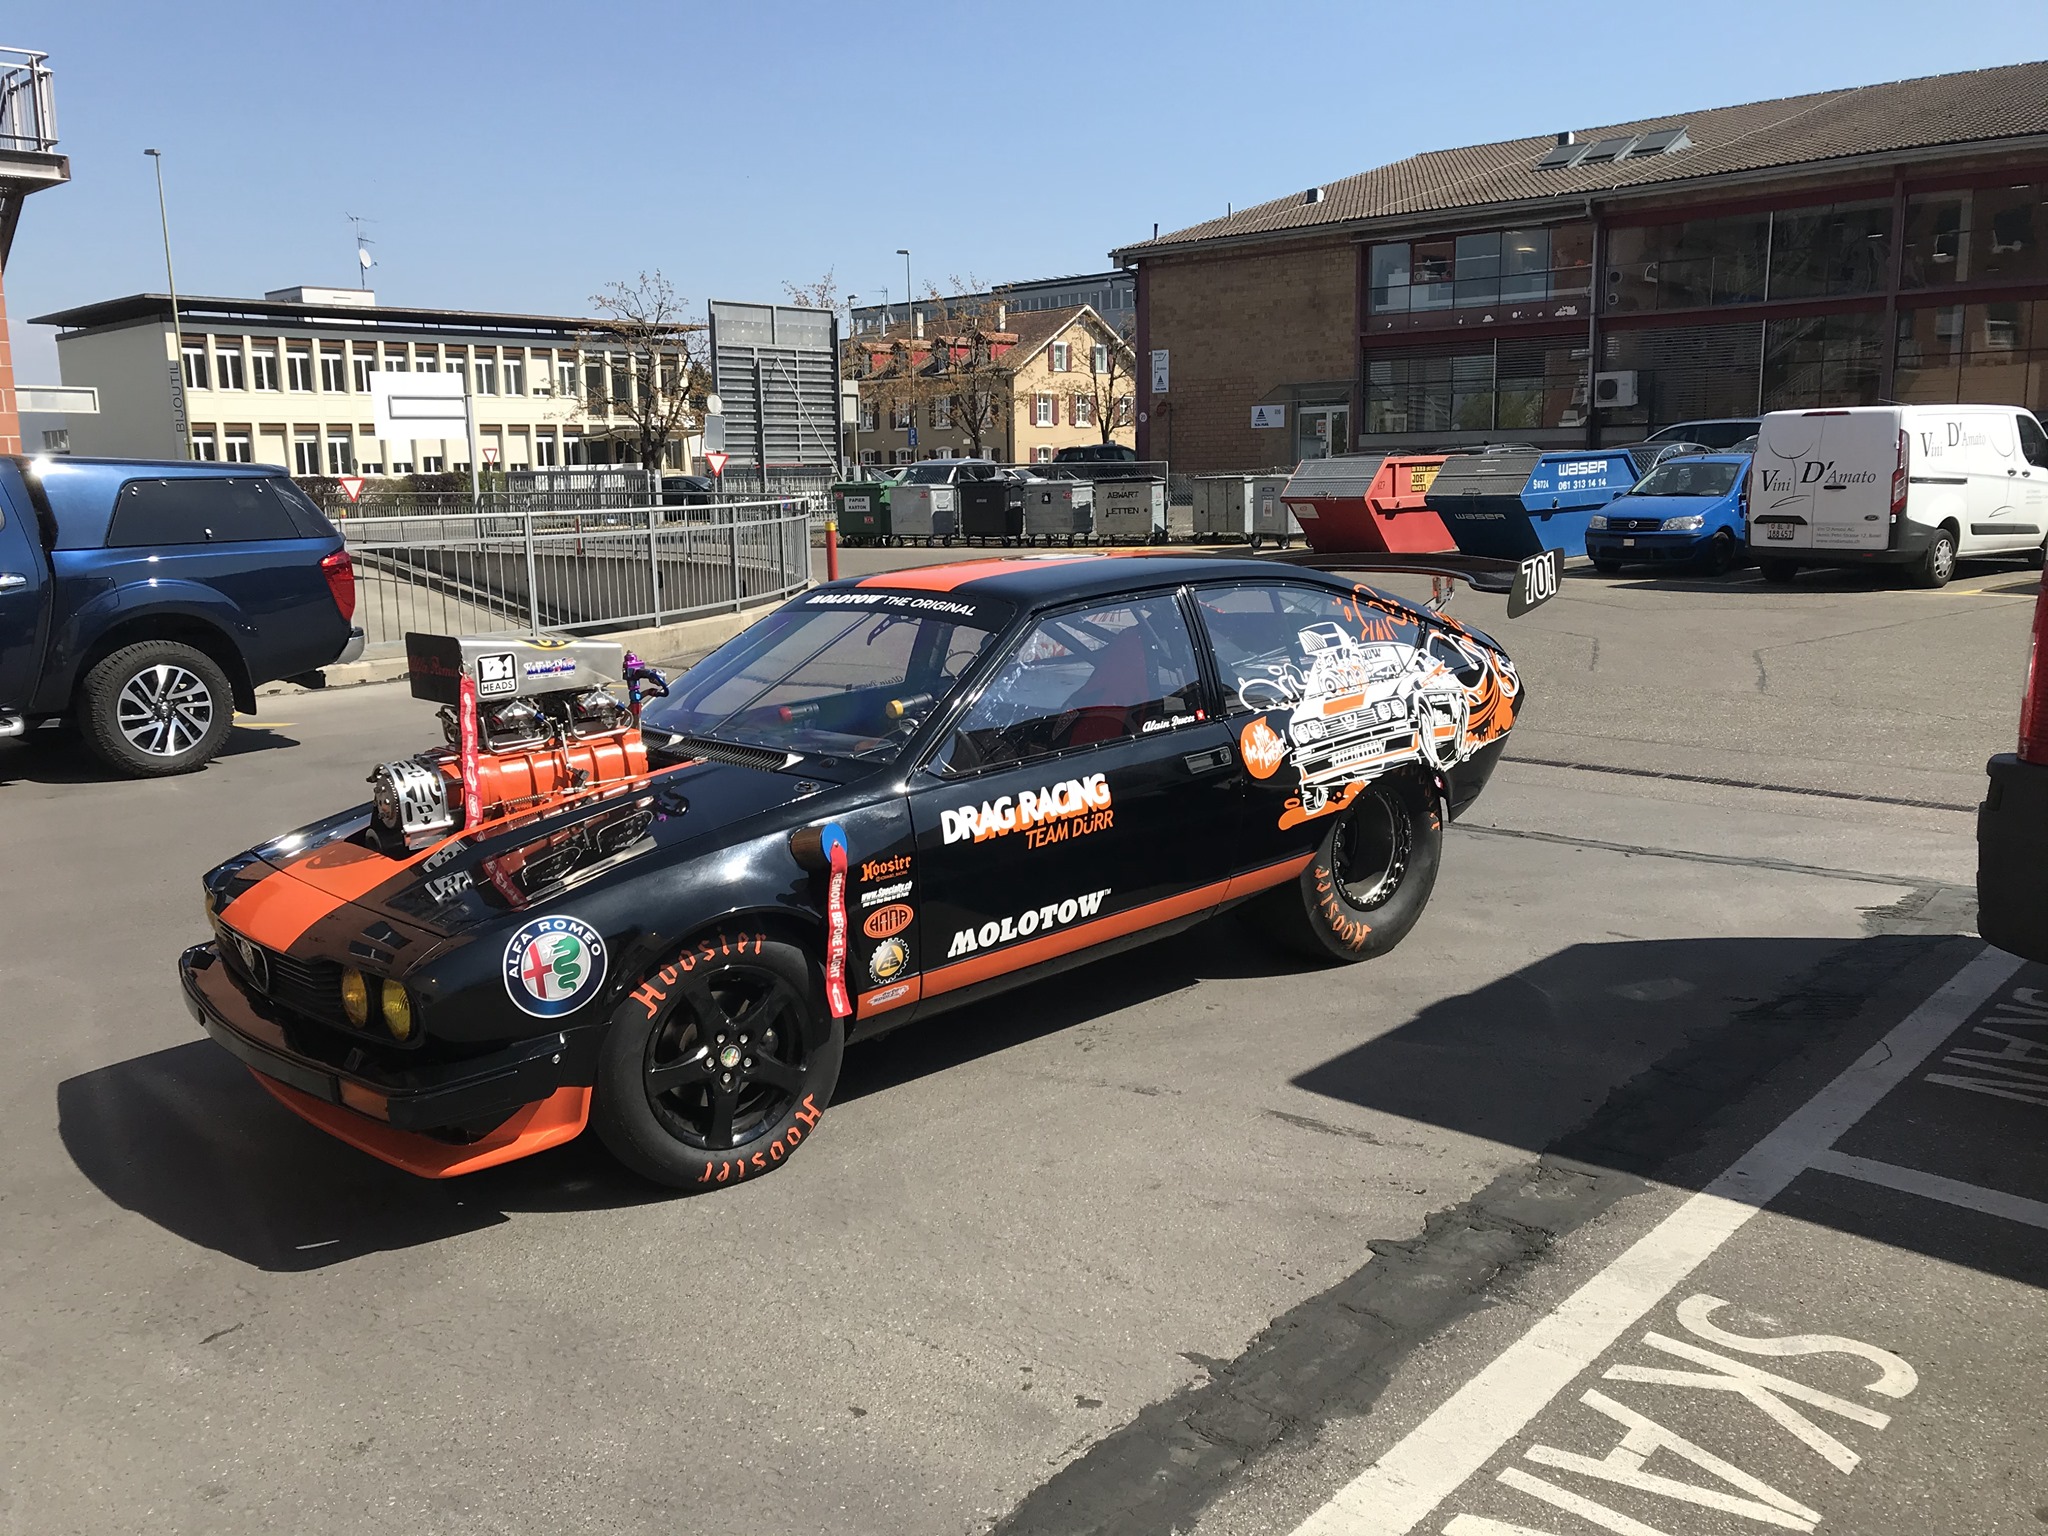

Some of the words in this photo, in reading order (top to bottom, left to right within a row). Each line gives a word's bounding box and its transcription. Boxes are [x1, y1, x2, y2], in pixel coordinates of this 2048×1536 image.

[169, 362, 186, 433] BIJOUTIL
[1920, 432, 1943, 457] Vini
[1412, 474, 1426, 483] JOST
[1558, 481, 1571, 491] 061
[1573, 480, 1586, 489] 313
[1588, 479, 1596, 488] 14
[1598, 478, 1607, 487] 14
[1761, 470, 1792, 492] Vini
[1800, 461, 1877, 483] D'Amato
[1107, 491, 1139, 499] ABWART
[1106, 507, 1139, 515] LETTEN
[1522, 551, 1557, 604] 701
[806, 594, 884, 604] MOLOTOW
[884, 596, 911, 606] THE
[911, 599, 977, 616] ORIGINAL
[482, 681, 513, 693] HEADS
[1142, 720, 1170, 732] Alain
[940, 796, 1015, 845] DRAG
[1018, 773, 1111, 826] RACING
[1025, 822, 1068, 850] TEAM
[860, 854, 912, 882] Hoosier
[829, 872, 843, 910] REMOVE
[1314, 865, 1372, 952] Hoosier
[831, 911, 844, 946] BEFORE
[947, 891, 1105, 958] MOLOTOW
[508, 932, 533, 978] ALFA
[538, 920, 601, 956] ROMEO
[829, 947, 844, 978] FLIGHT
[629, 931, 767, 1020] Hoosier
[697, 1093, 822, 1183] Hoosier
[1441, 1294, 1918, 1536] SKA
